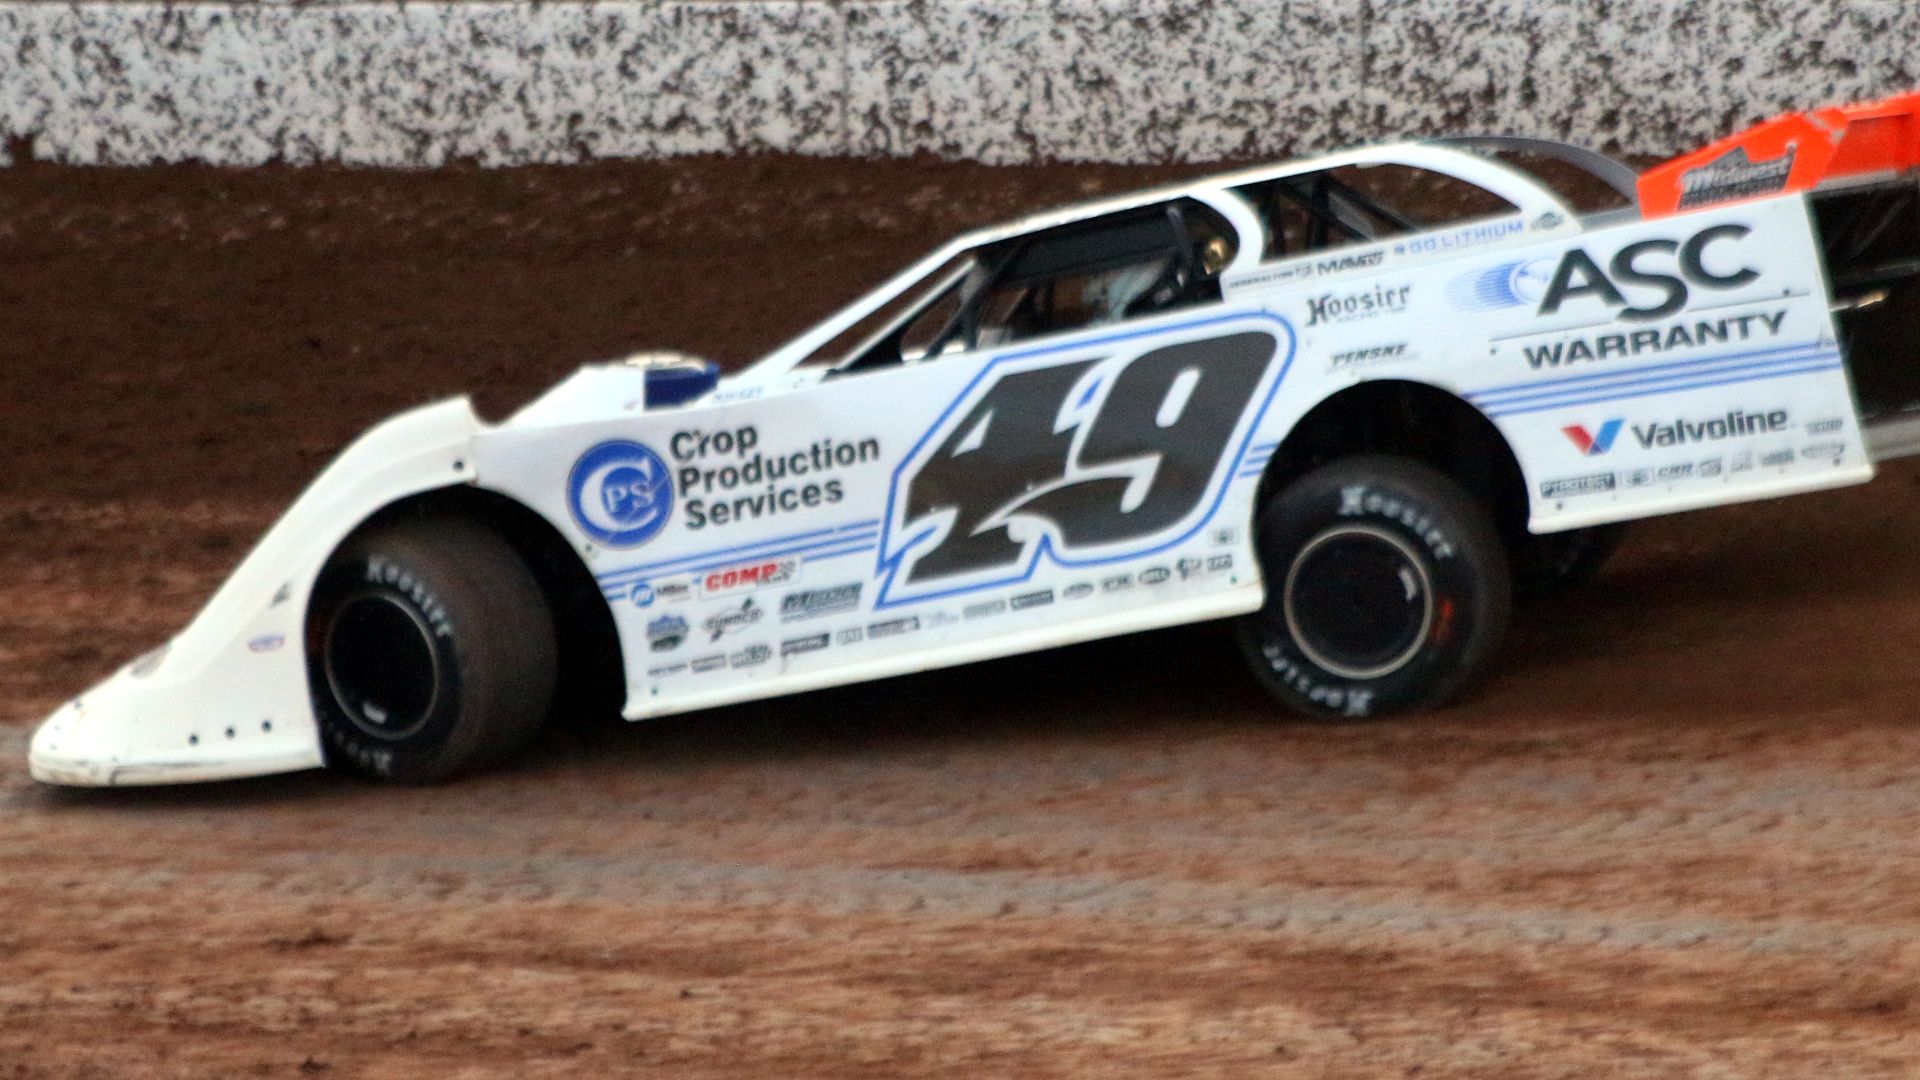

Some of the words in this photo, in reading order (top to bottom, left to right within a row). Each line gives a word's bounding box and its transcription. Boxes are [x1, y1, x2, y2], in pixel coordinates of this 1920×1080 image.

[1441, 219, 1524, 249] LITHIUM
[1535, 224, 1761, 325] ASC
[1306, 284, 1410, 327] Hoosier
[1522, 309, 1788, 371] WARRANTY
[669, 423, 758, 462] Crop
[1631, 409, 1789, 450] Valvoline
[678, 436, 880, 498] Production
[902, 329, 1280, 586] 49
[685, 478, 845, 530] Services
[705, 563, 778, 592] COMP
